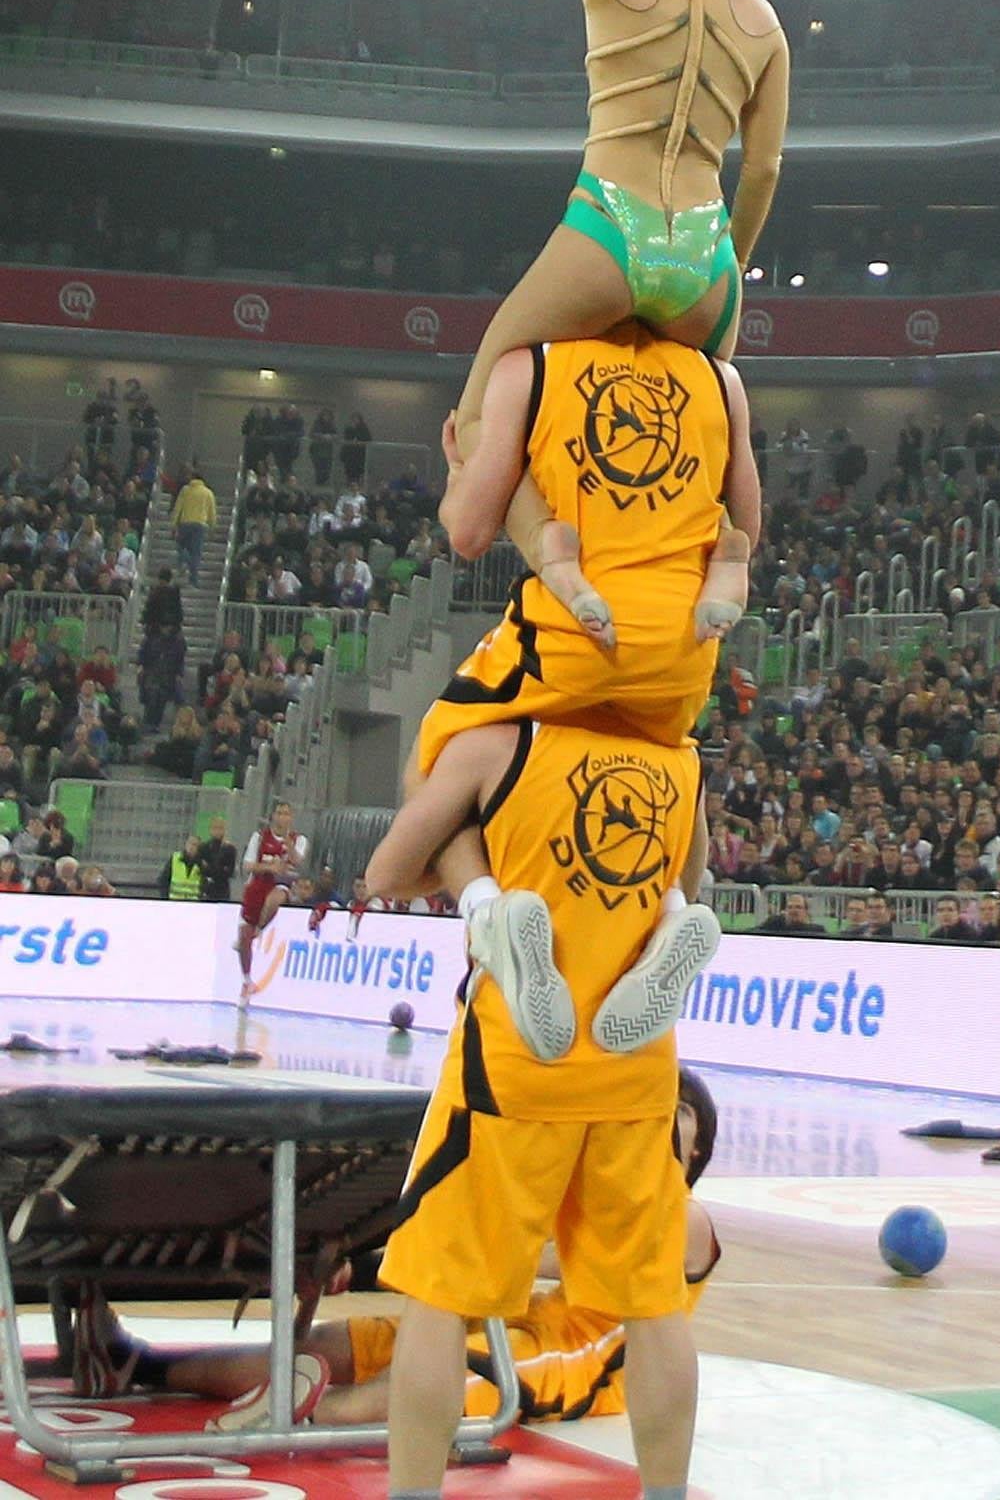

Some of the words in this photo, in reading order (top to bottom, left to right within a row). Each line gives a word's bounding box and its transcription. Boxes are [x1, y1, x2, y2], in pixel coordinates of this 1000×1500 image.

[597, 363, 665, 388] DUNING
[564, 436, 700, 511] DEVILS
[591, 752, 661, 780] DUNKING
[283, 931, 434, 992] mimovrste
